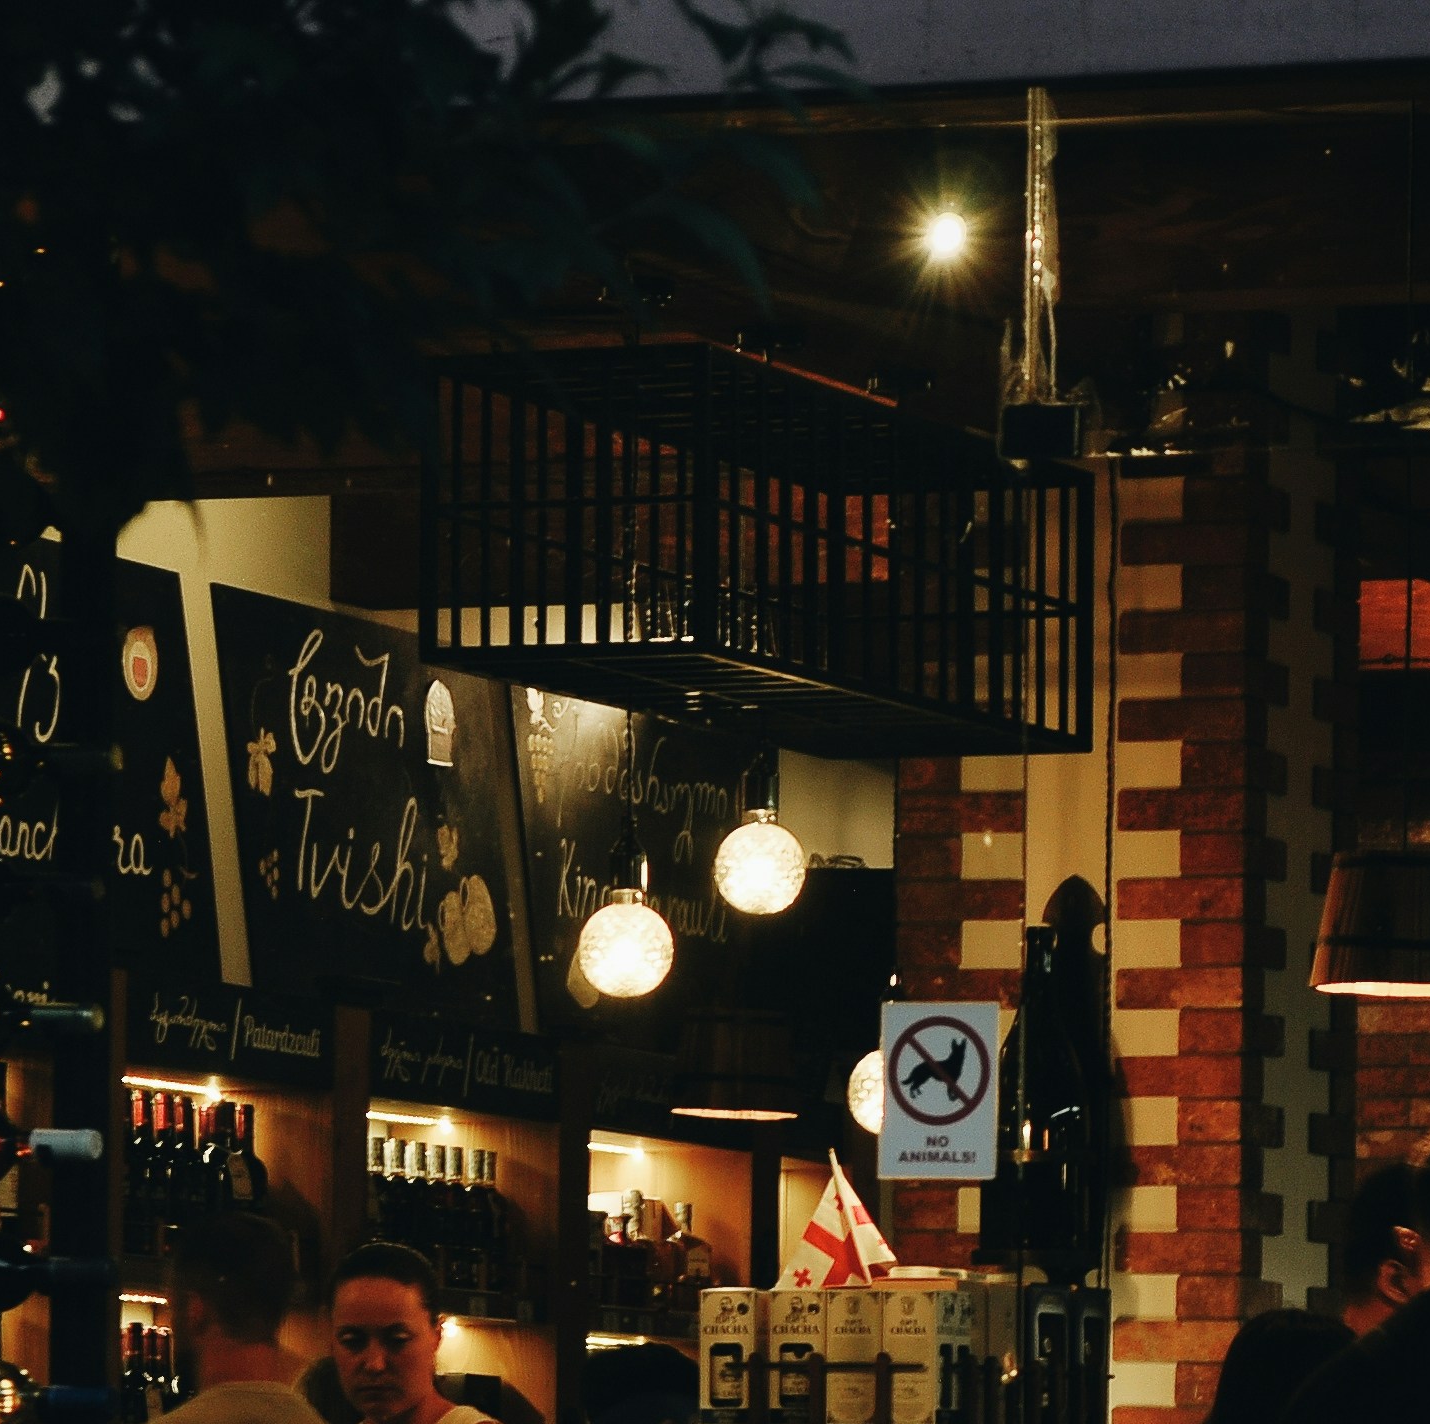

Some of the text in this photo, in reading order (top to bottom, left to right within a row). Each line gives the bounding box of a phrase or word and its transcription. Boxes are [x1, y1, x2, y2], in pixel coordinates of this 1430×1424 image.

[292, 787, 431, 933] Tvishi
[926, 1136, 950, 1148] NO
[898, 1149, 977, 1165] ANIMALS!
[702, 1323, 750, 1336] CHACHA
[772, 1323, 820, 1336] CHACHA
[833, 1324, 872, 1335] CHACHA
[889, 1325, 927, 1336] CHACHA
